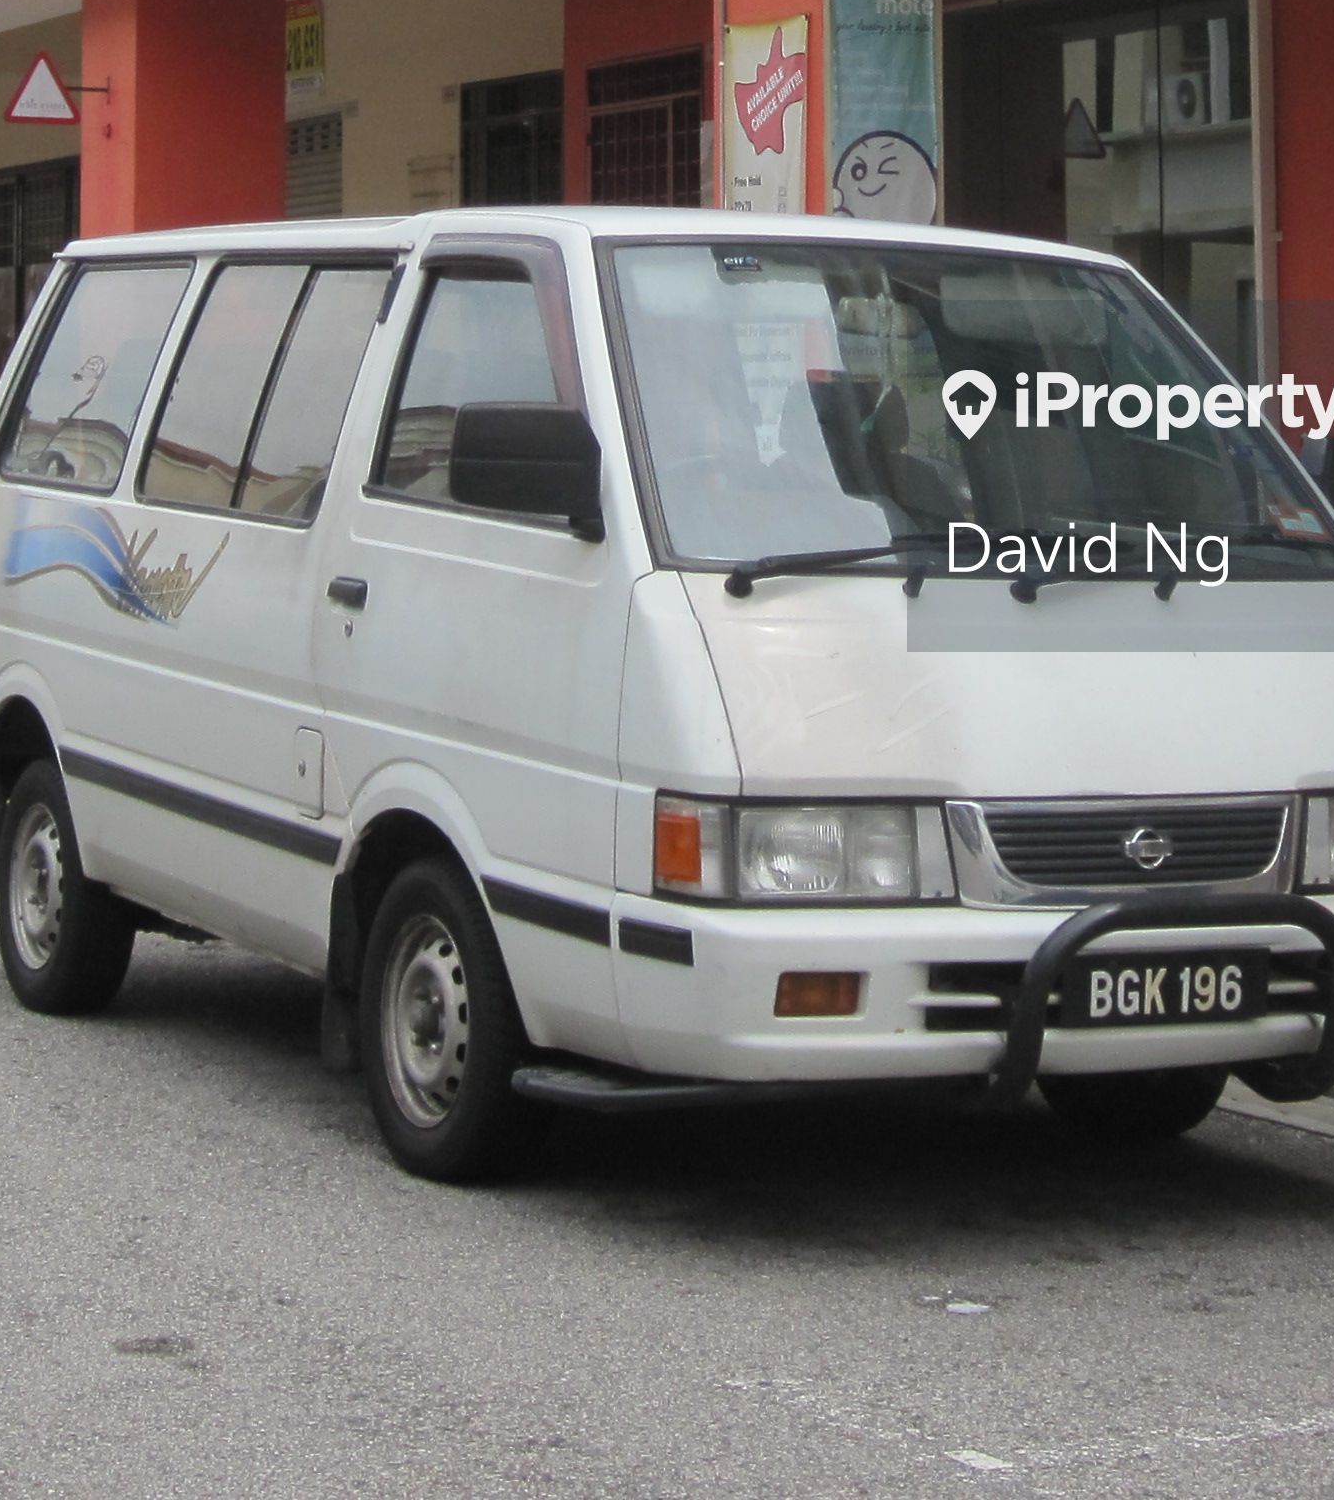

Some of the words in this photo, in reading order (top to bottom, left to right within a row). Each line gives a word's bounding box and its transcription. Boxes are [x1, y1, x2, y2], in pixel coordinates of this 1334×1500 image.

[746, 66, 785, 115] AVAILABLE
[751, 97, 778, 132] CHOICE
[1089, 968, 1167, 1018] BGK
[1179, 965, 1243, 1013] 196
